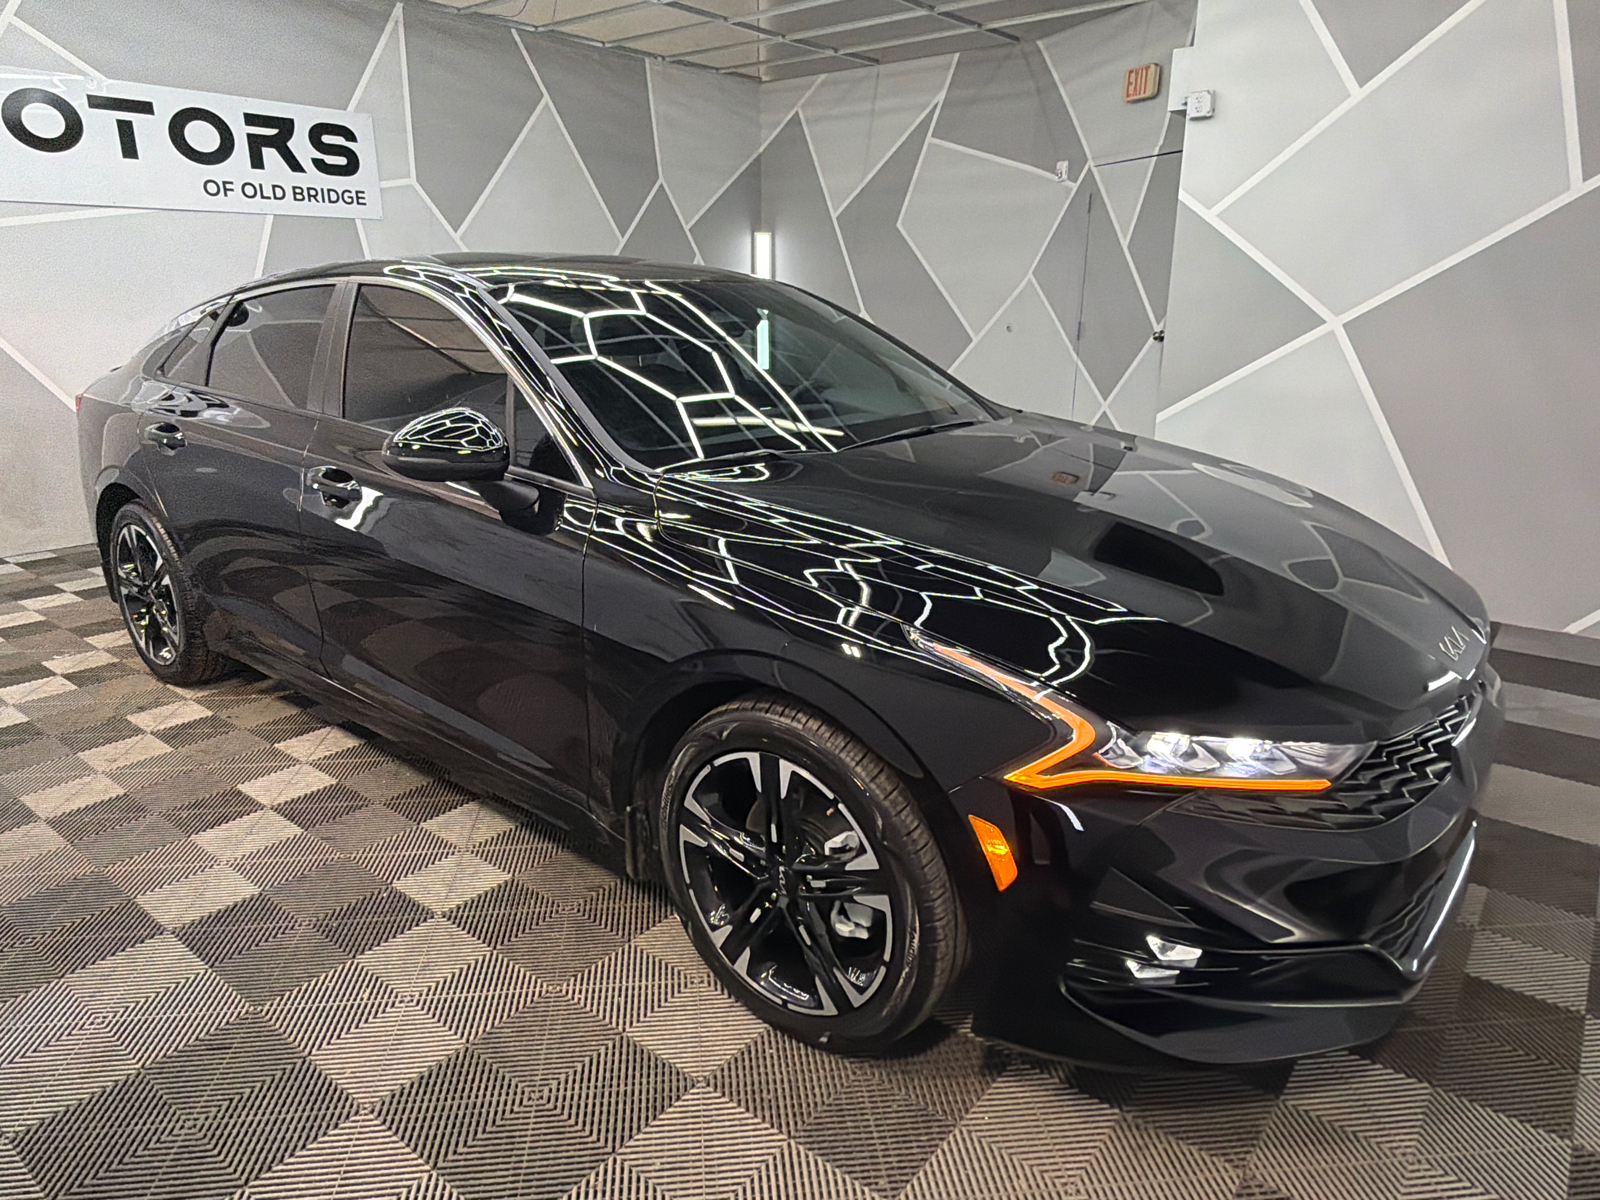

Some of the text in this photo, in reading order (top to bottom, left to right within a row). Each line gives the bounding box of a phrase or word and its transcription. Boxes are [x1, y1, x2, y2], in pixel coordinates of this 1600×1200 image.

[1126, 65, 1151, 98] EXIT
[1, 87, 360, 178] OTORS
[203, 179, 367, 206] OF OLD BRIDGE
